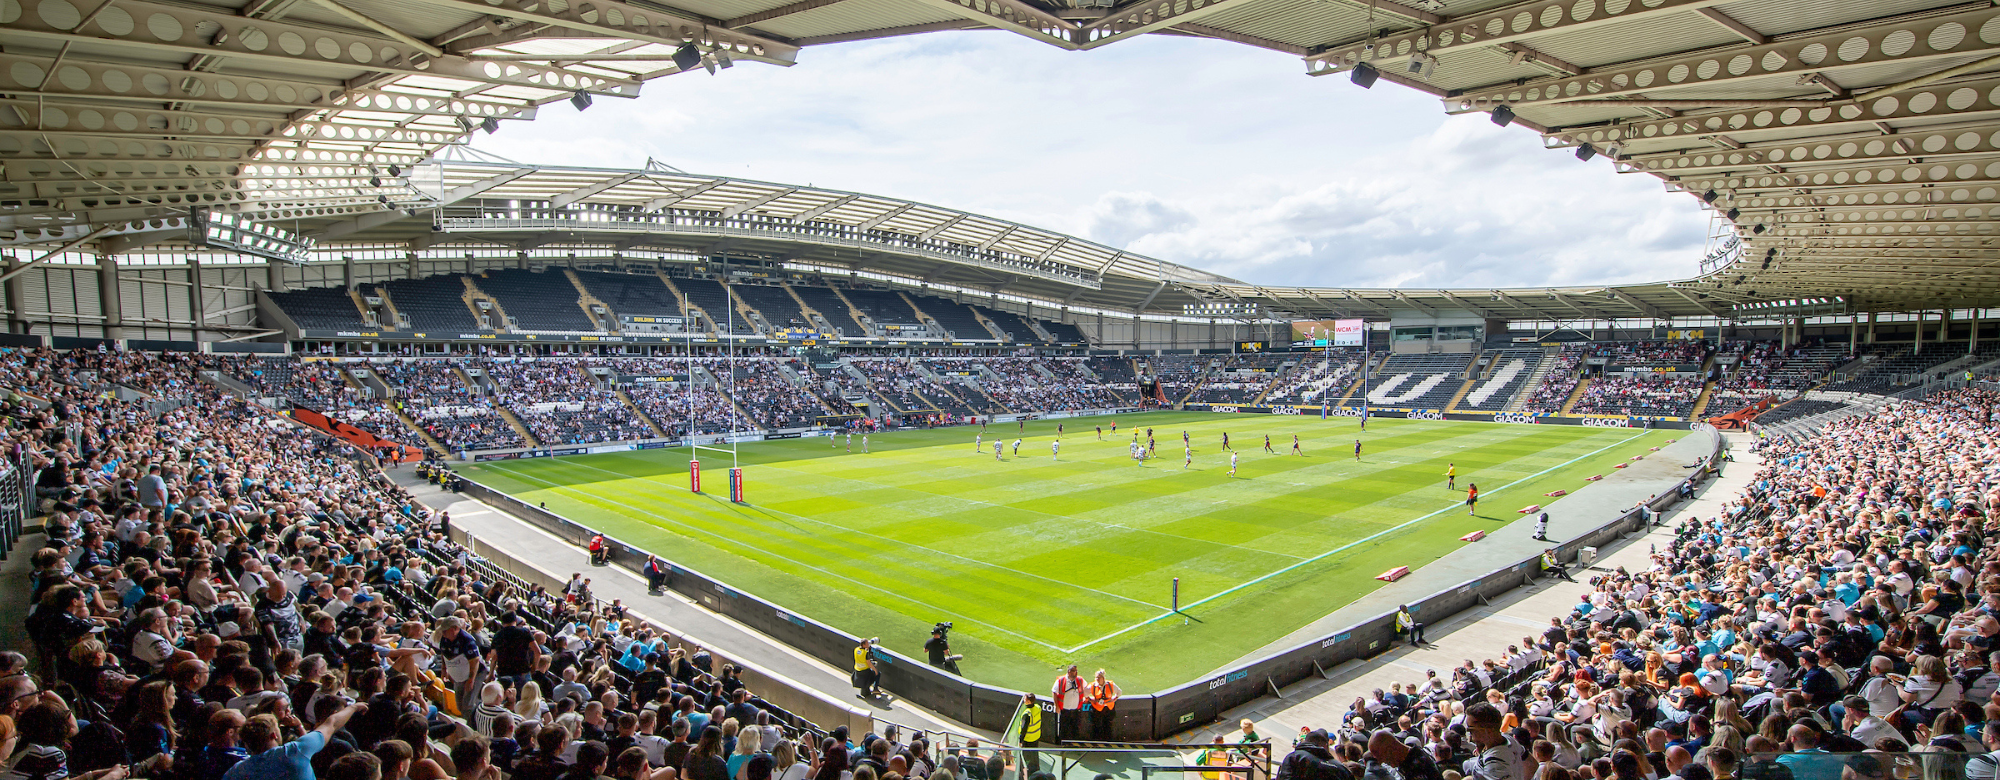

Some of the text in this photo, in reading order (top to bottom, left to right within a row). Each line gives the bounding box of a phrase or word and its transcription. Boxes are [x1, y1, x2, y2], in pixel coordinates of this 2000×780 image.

[1667, 330, 1704, 341] MKM
[1241, 342, 1262, 352] MKM
[1209, 669, 1248, 690] totalfitness
